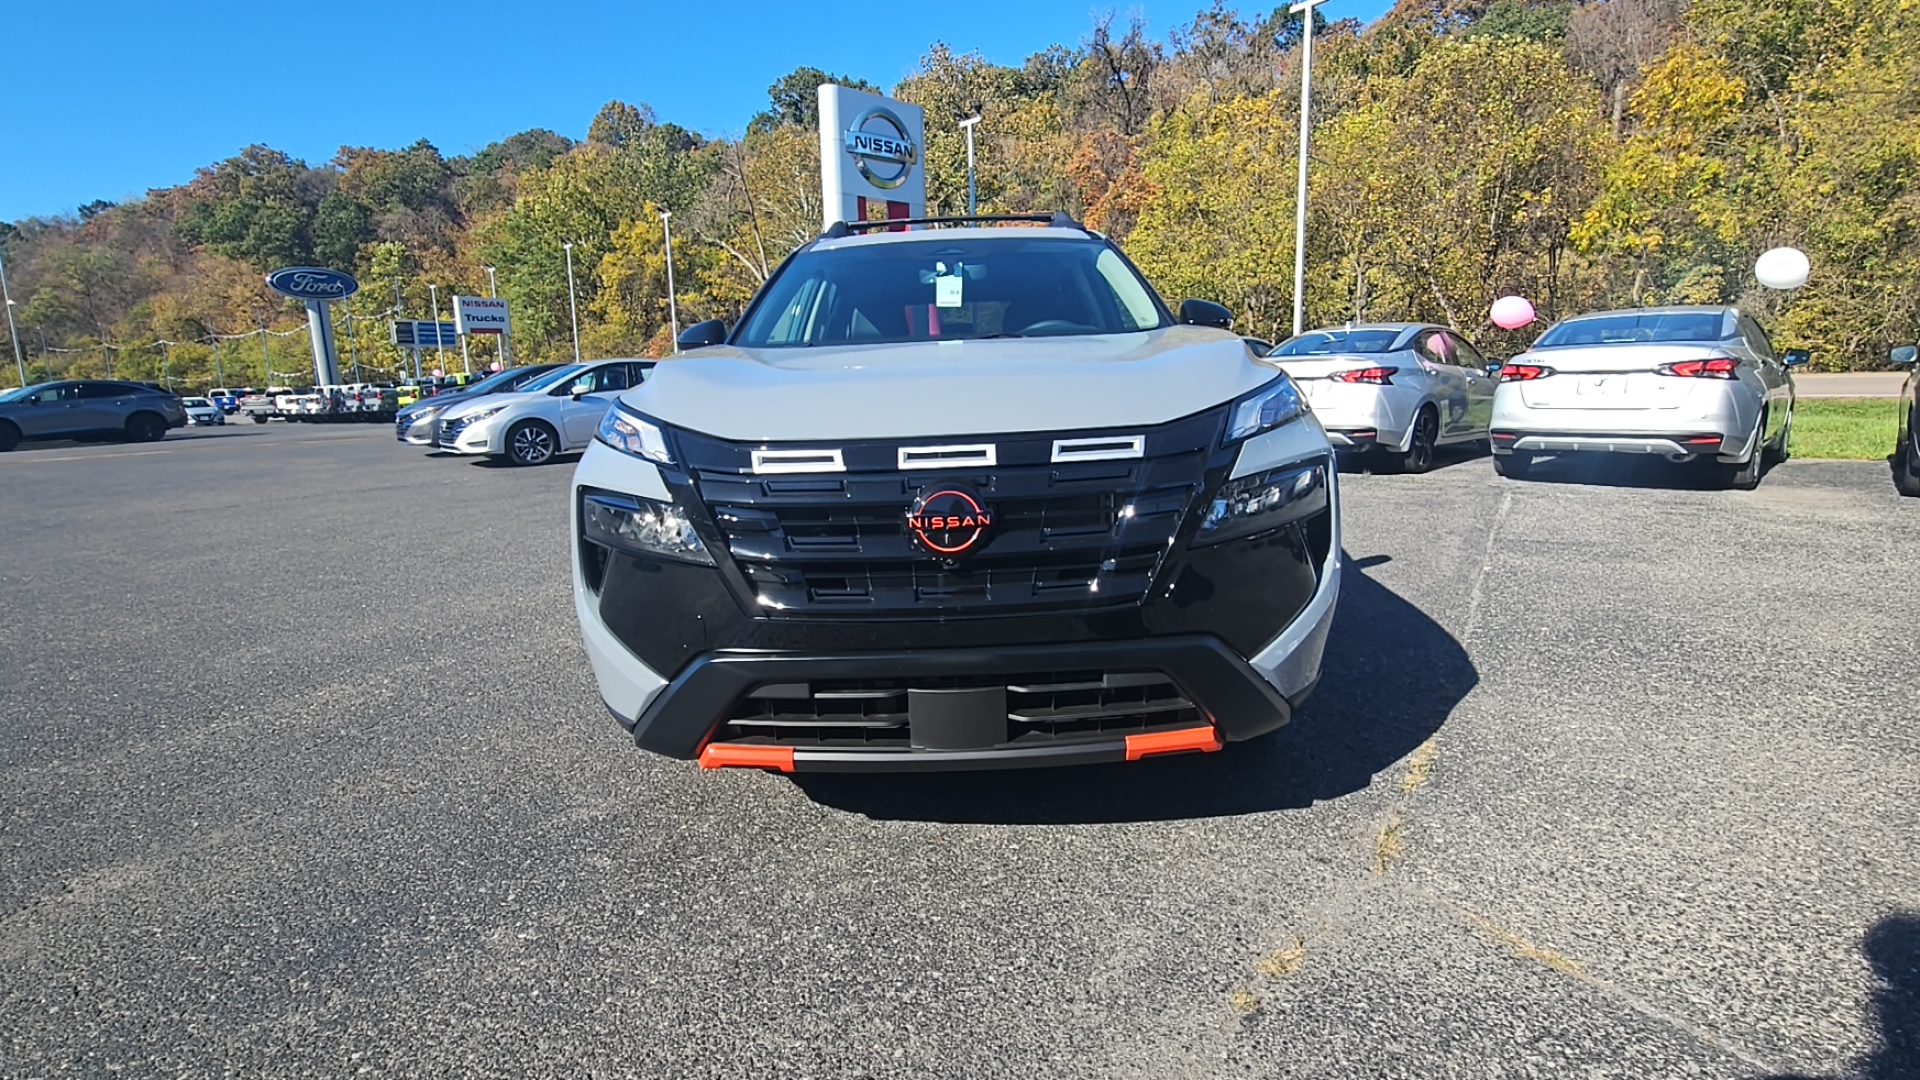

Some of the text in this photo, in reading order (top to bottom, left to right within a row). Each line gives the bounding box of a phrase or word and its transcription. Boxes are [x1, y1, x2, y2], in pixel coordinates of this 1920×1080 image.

[855, 136, 913, 158] NISSAN
[290, 273, 340, 293] Ford
[462, 299, 505, 309] NISSAN
[464, 313, 506, 323] Trucks
[908, 514, 990, 530] NISSAN
